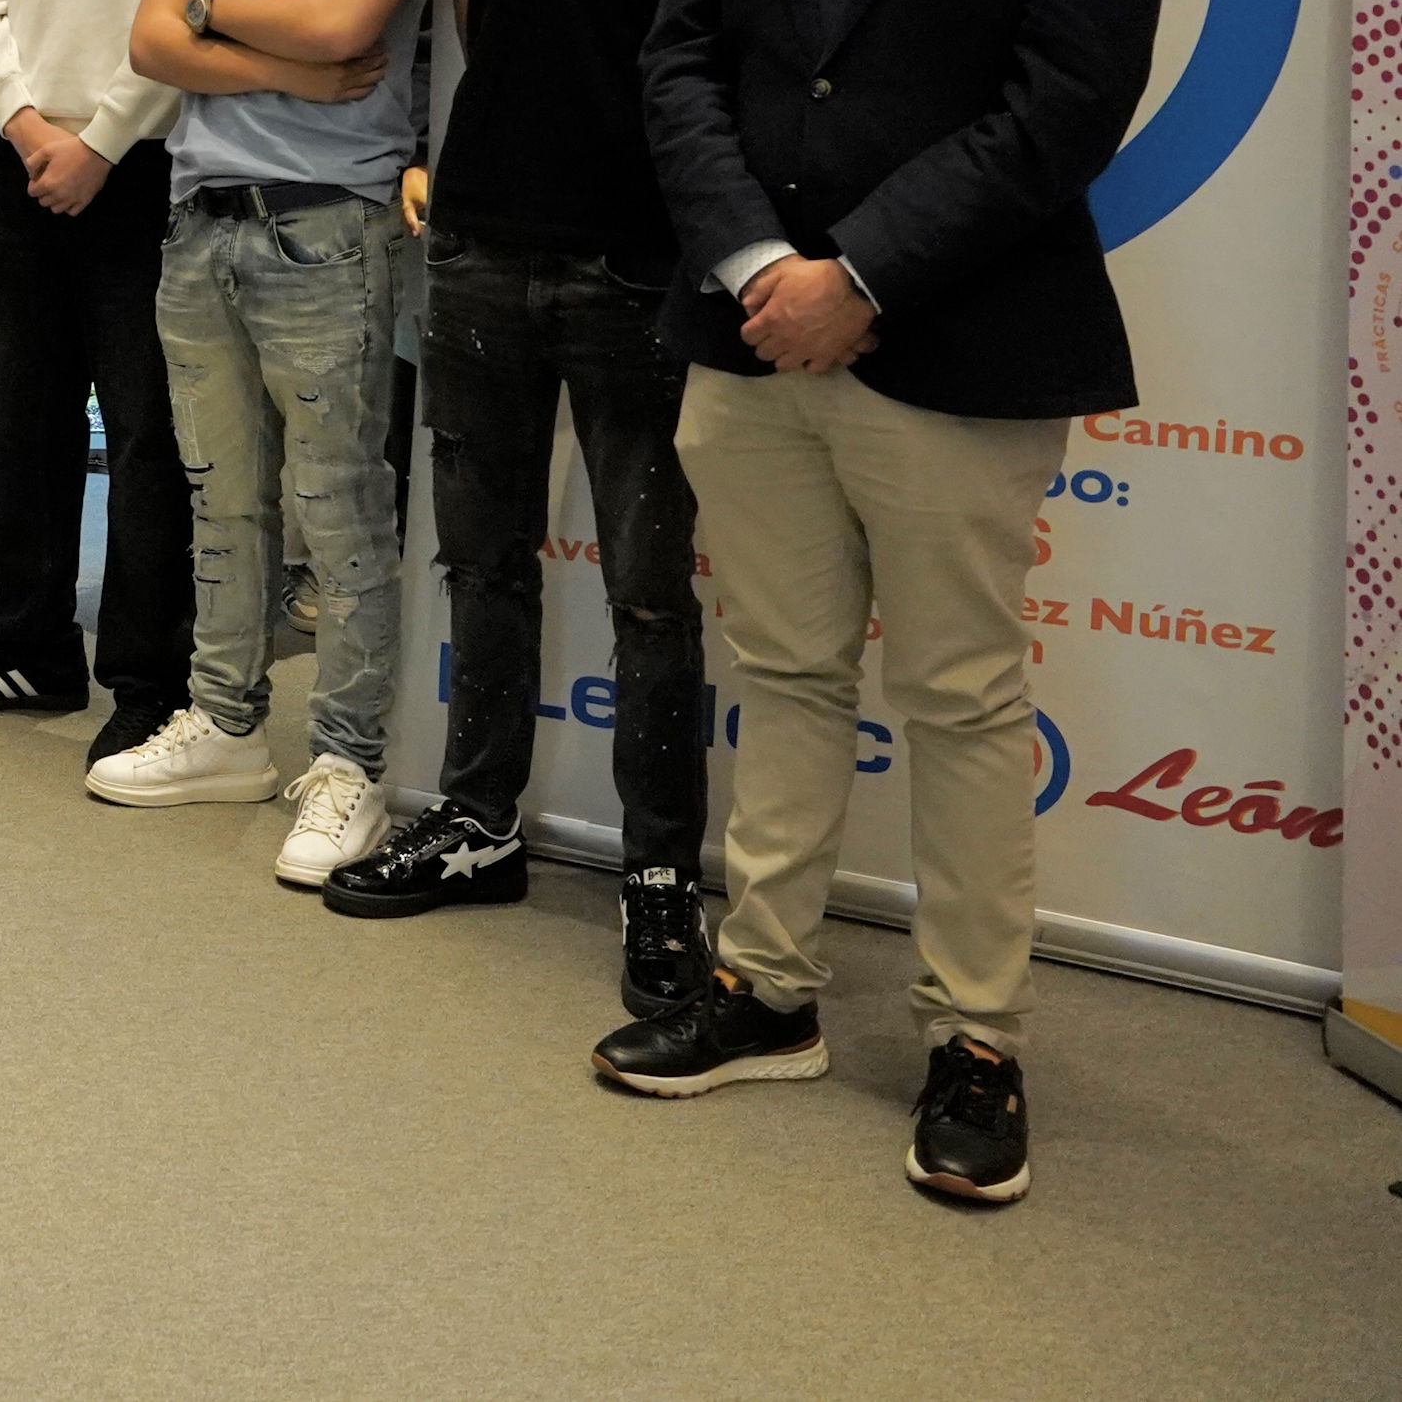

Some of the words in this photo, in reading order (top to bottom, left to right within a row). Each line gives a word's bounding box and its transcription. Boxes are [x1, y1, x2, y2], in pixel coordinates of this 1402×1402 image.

[1082, 411, 1305, 461] Camino
[1090, 597, 1277, 655] Núñez
[1084, 747, 1344, 848] León
